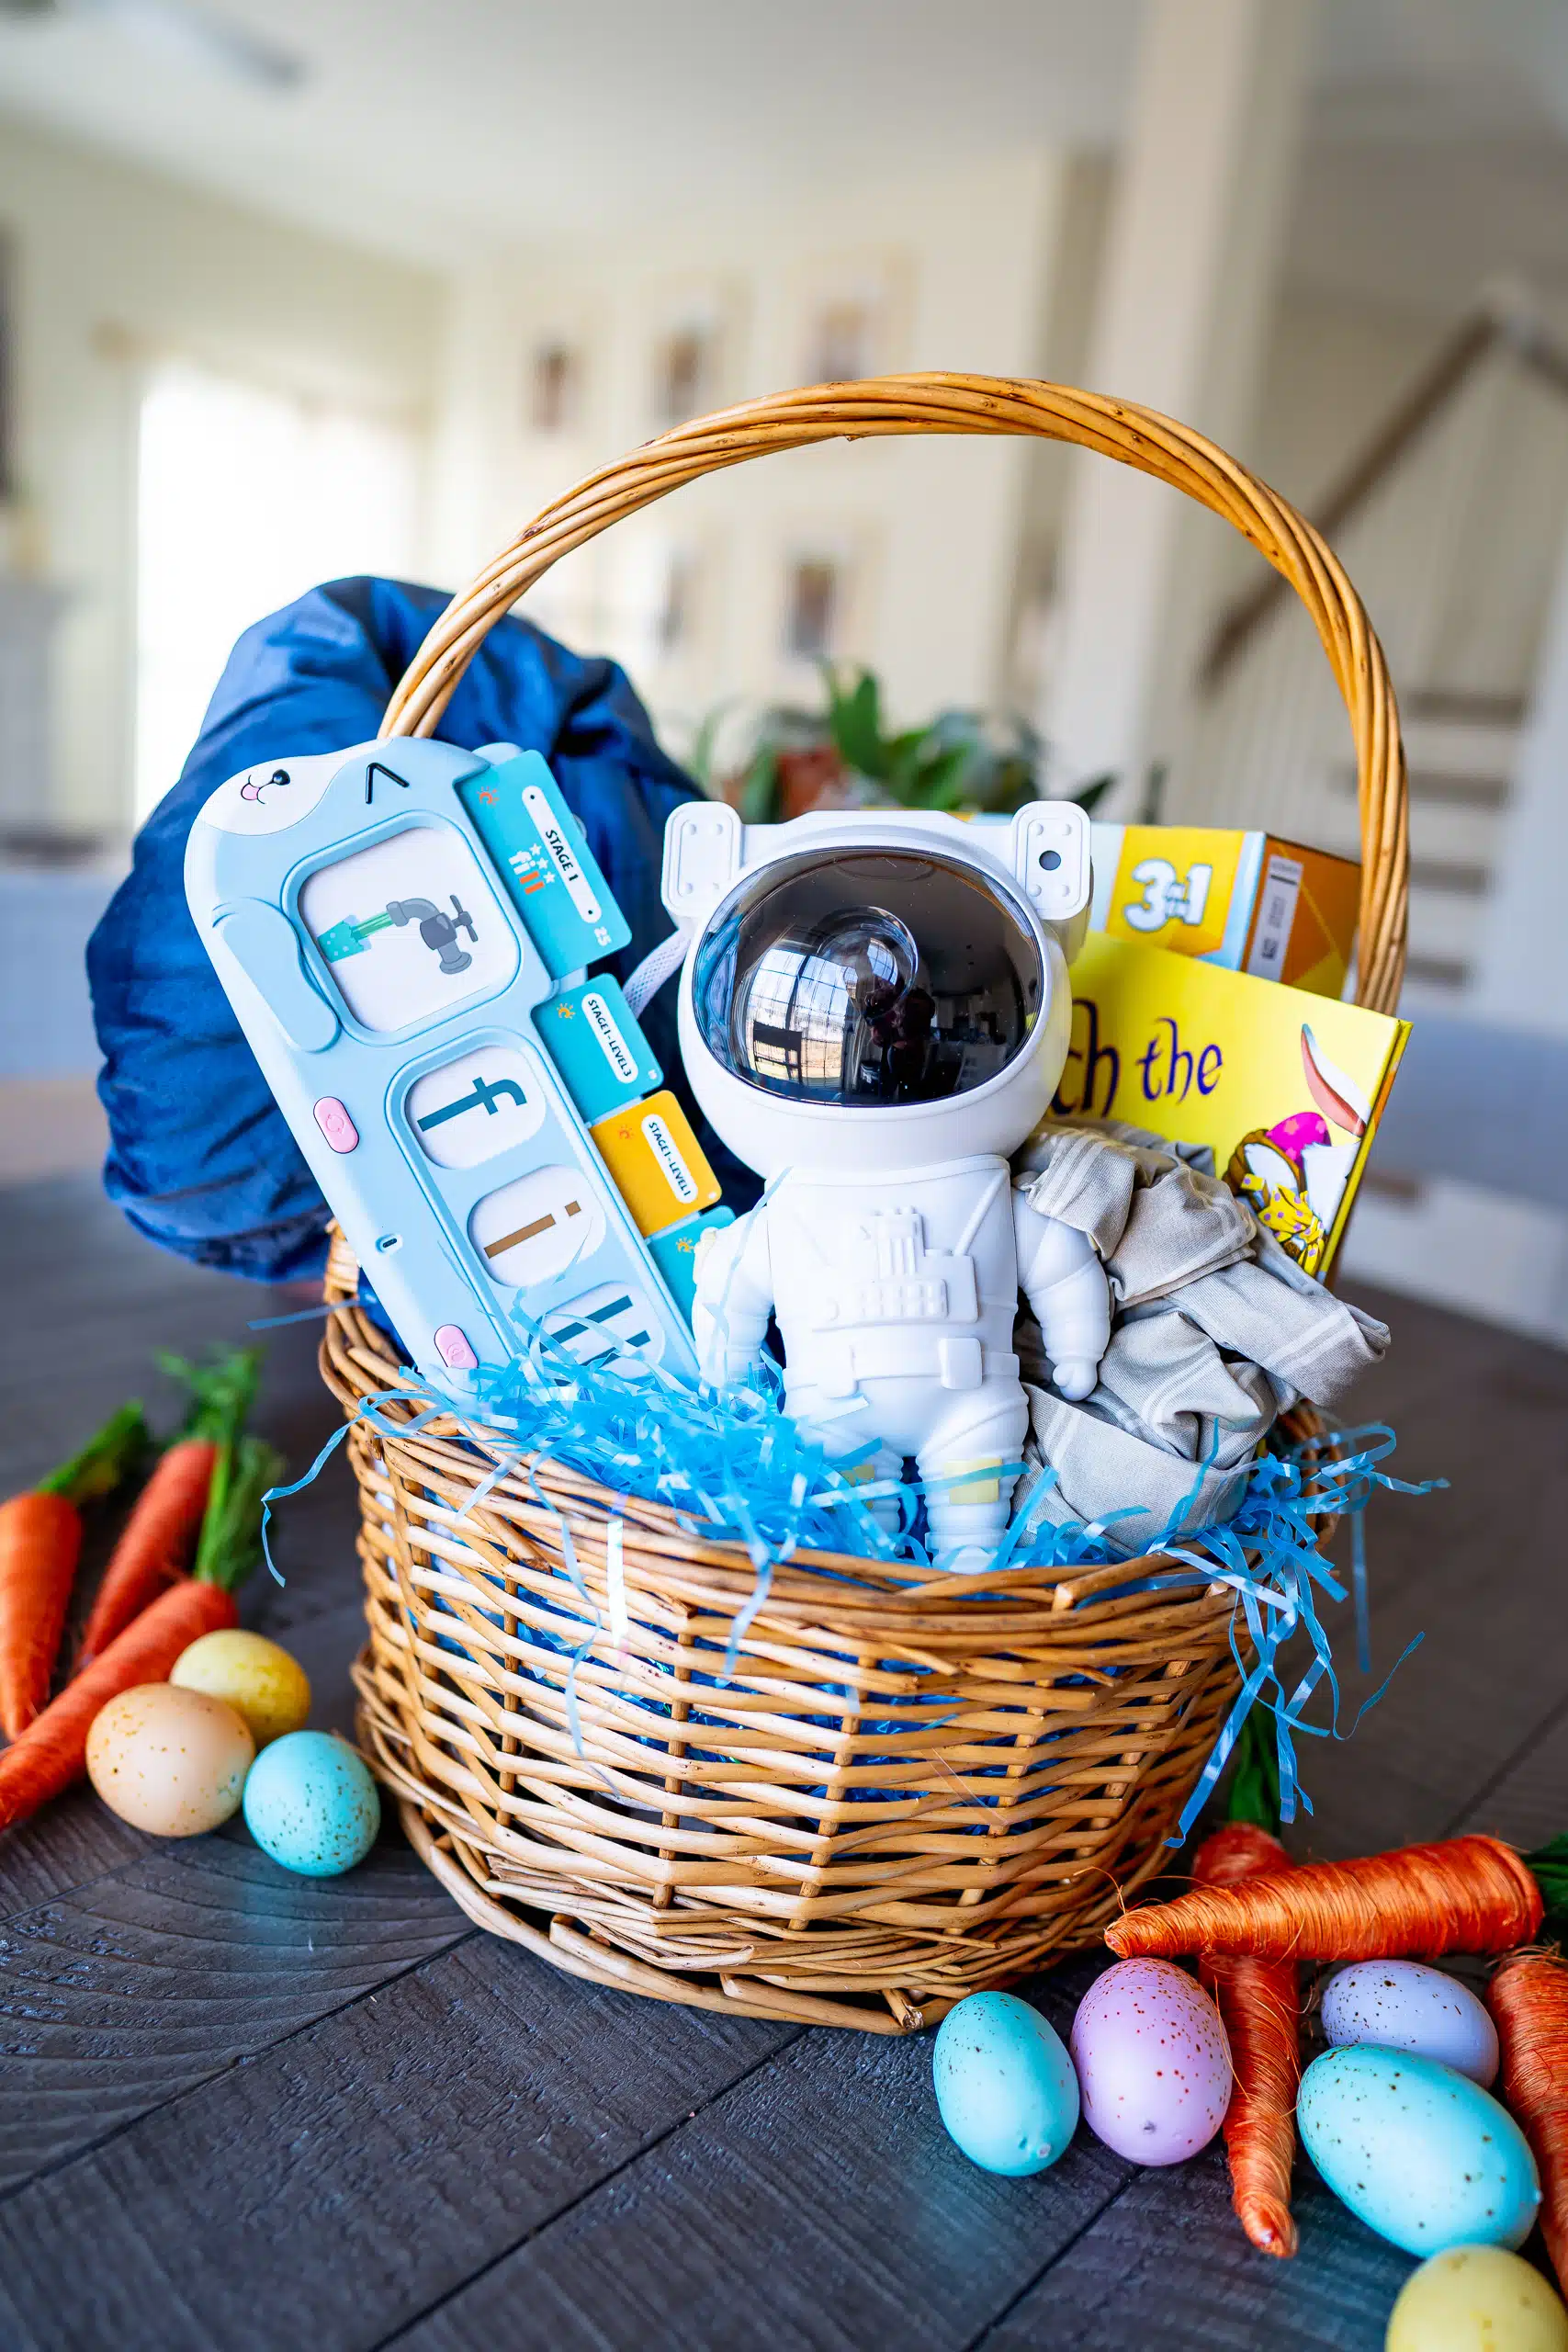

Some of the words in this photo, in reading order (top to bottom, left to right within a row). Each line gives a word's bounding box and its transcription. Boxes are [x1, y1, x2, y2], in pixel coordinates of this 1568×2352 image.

[545, 829, 574, 872] STAGE
[1134, 1016, 1224, 1105] the
[416, 1076, 527, 1133] f
[483, 1200, 581, 1260] i
